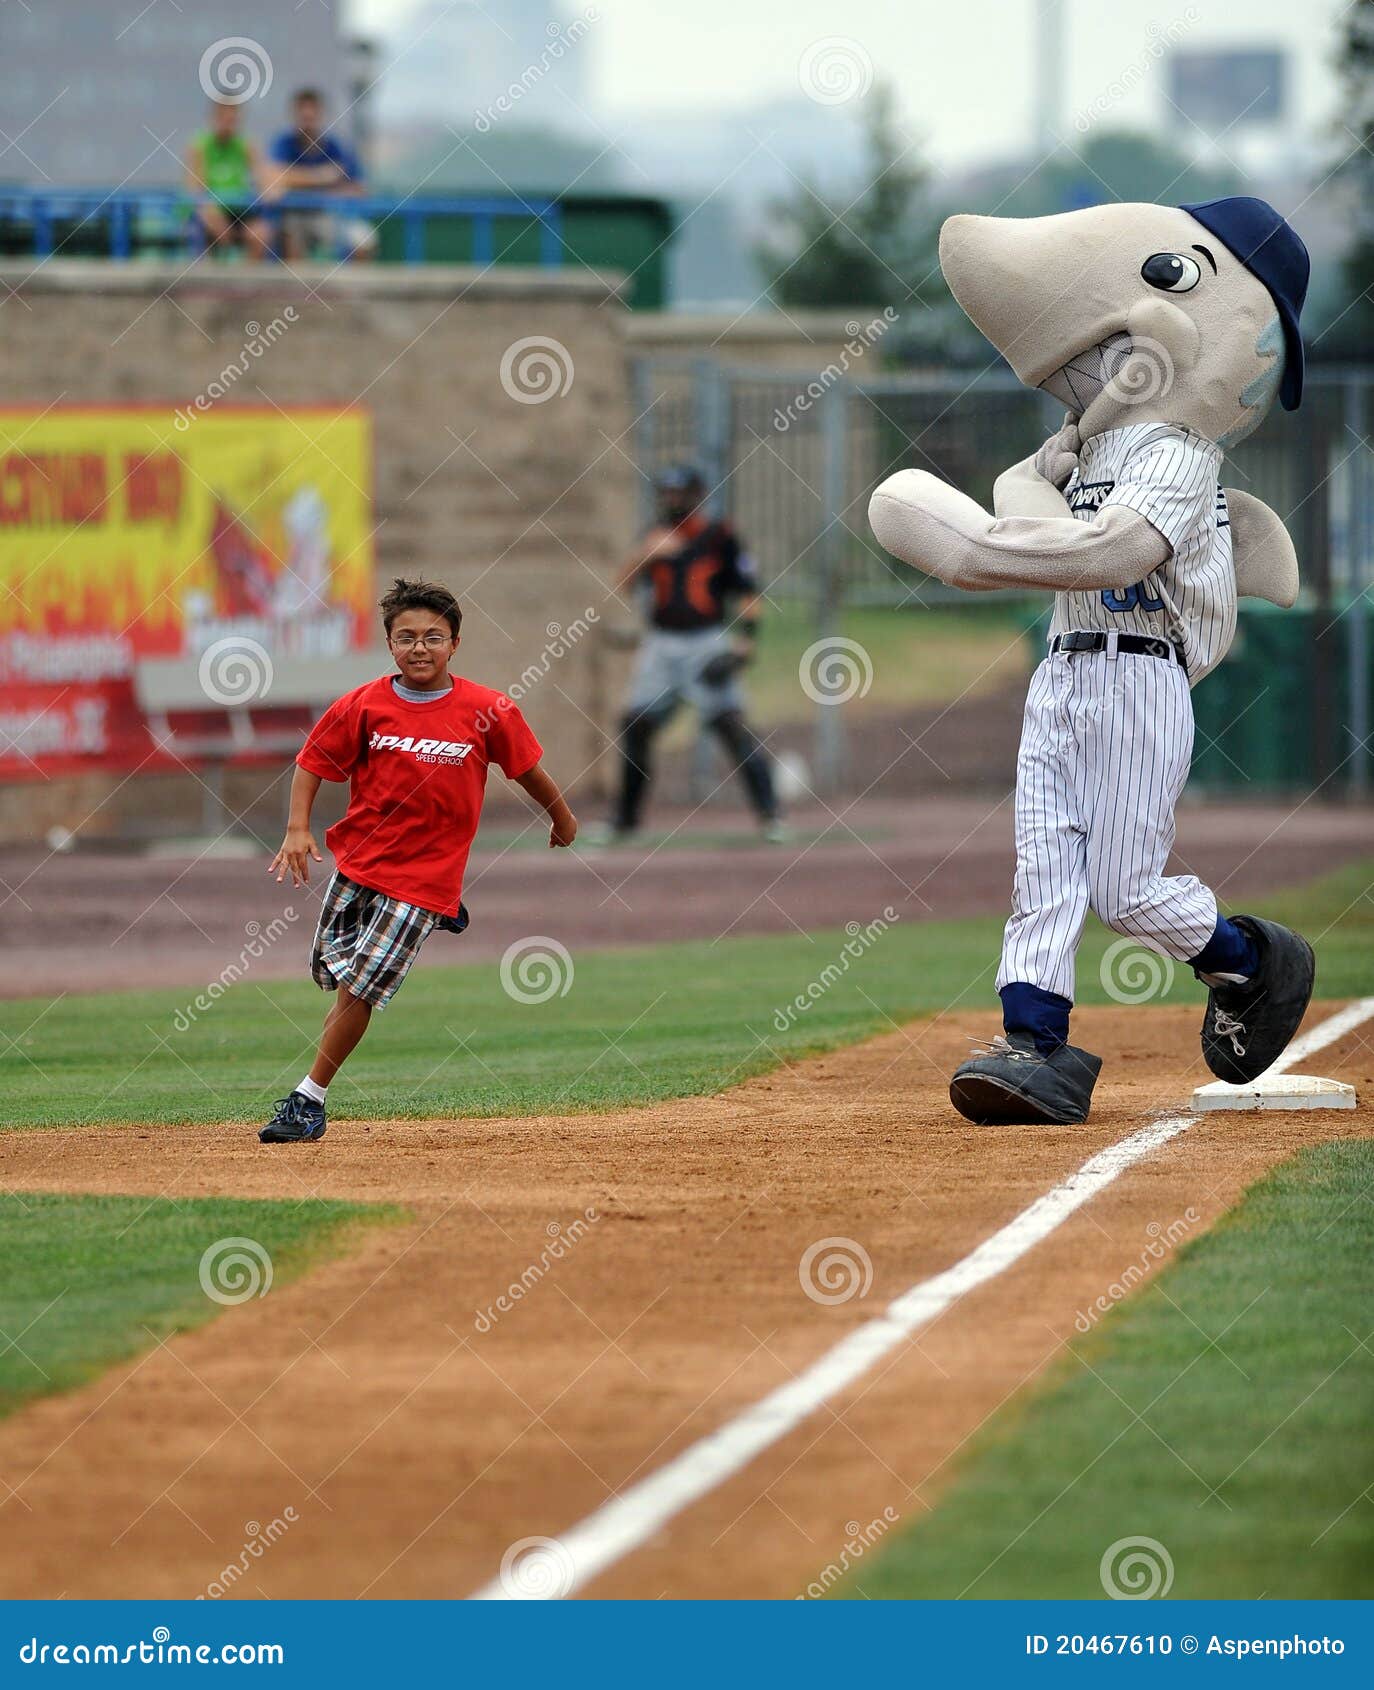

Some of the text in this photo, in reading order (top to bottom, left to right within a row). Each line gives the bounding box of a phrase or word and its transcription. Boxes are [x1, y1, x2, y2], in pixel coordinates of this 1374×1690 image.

[376, 735, 474, 758] PARISI
[415, 753, 463, 767] SPEED SCHOOL
